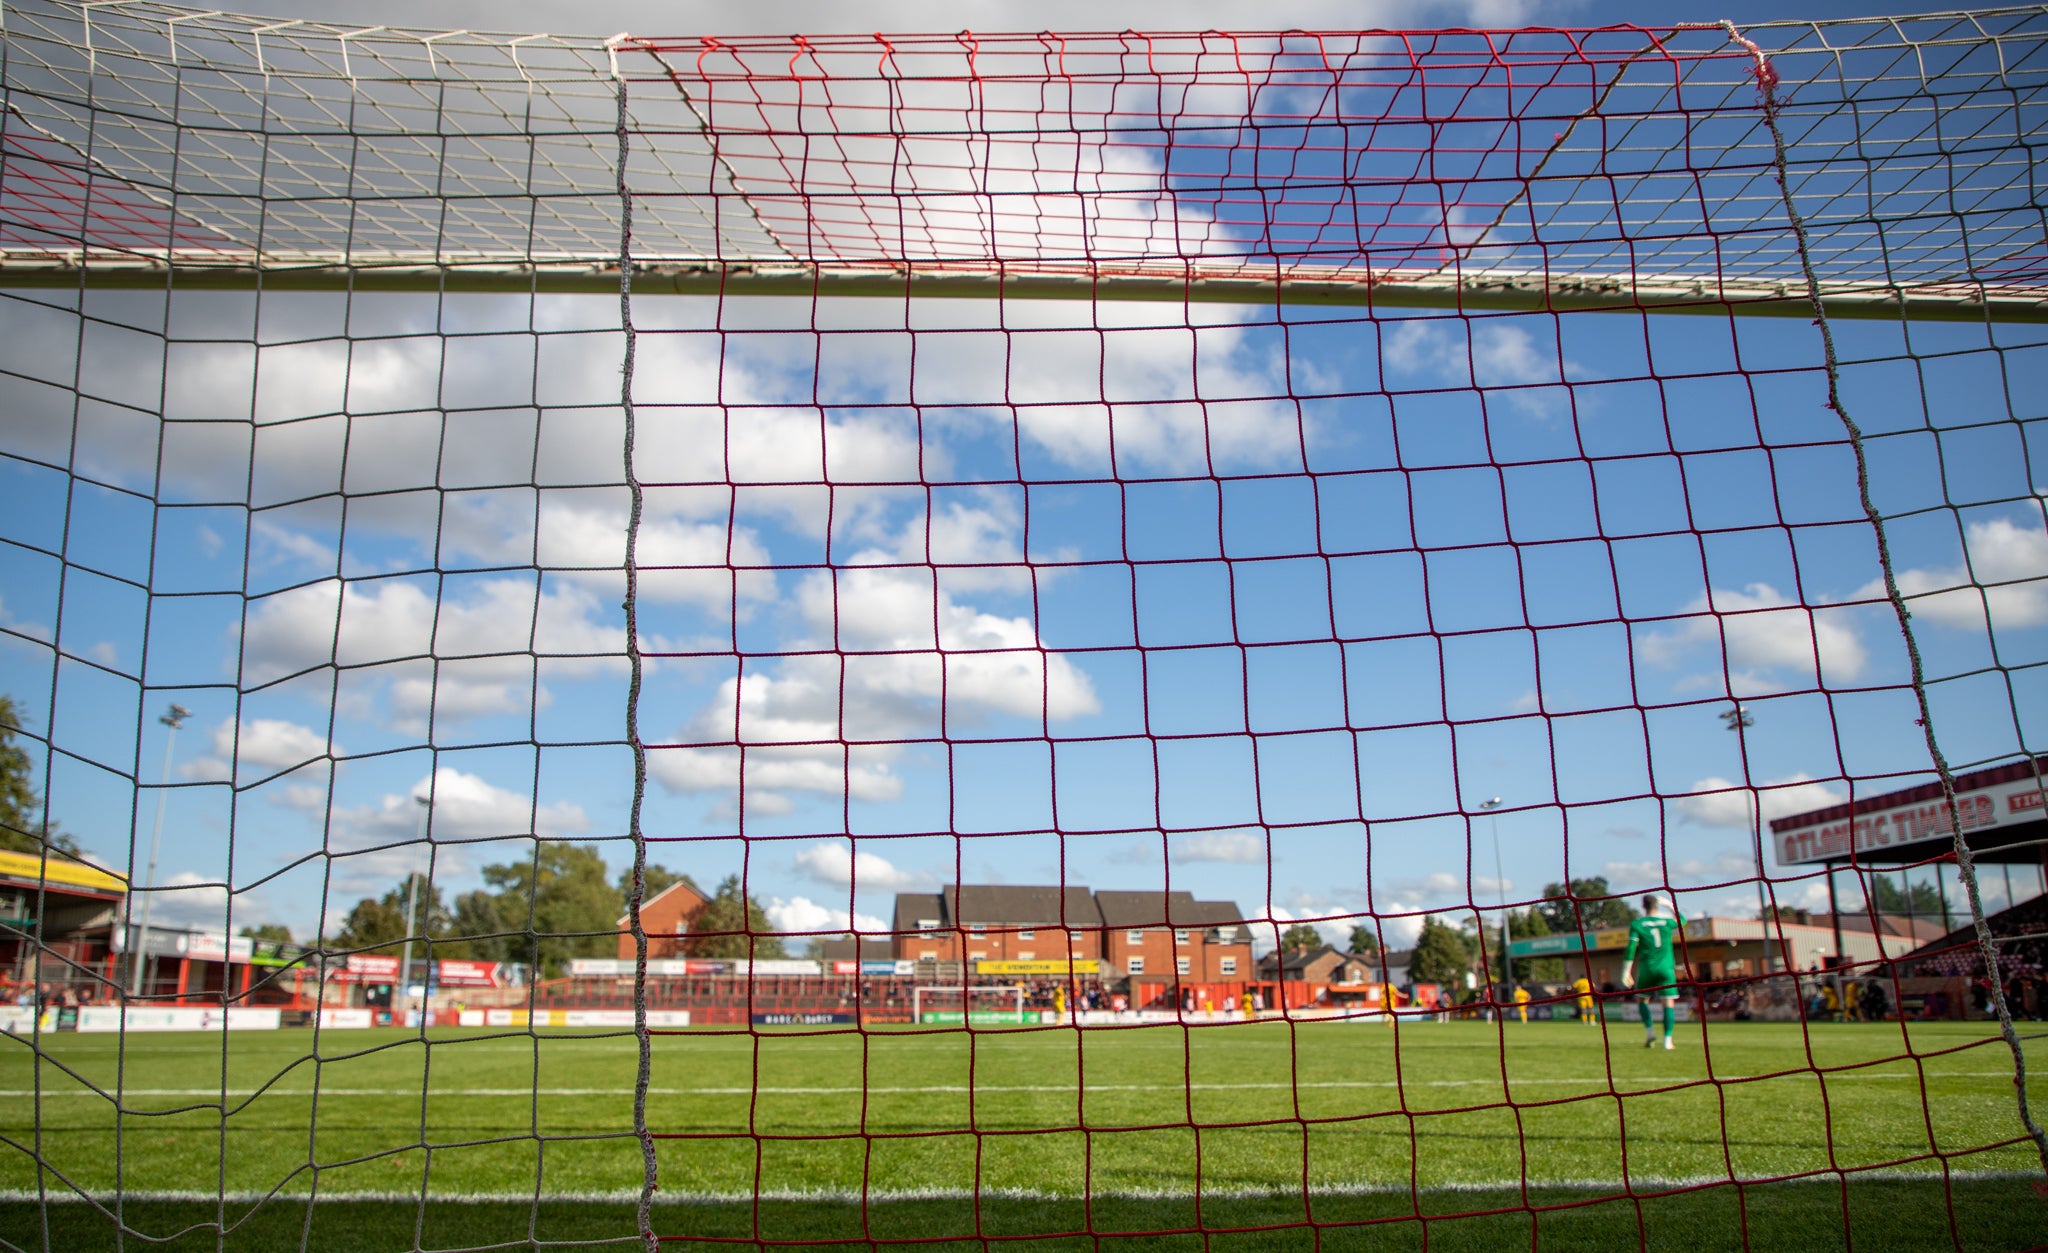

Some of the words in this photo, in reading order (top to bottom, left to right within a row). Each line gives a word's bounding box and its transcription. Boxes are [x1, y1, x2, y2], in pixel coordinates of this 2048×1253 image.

[1784, 815, 1890, 862] ATLANTIC
[1891, 795, 1998, 842] TIMBER
[1650, 928, 1662, 948] 1
